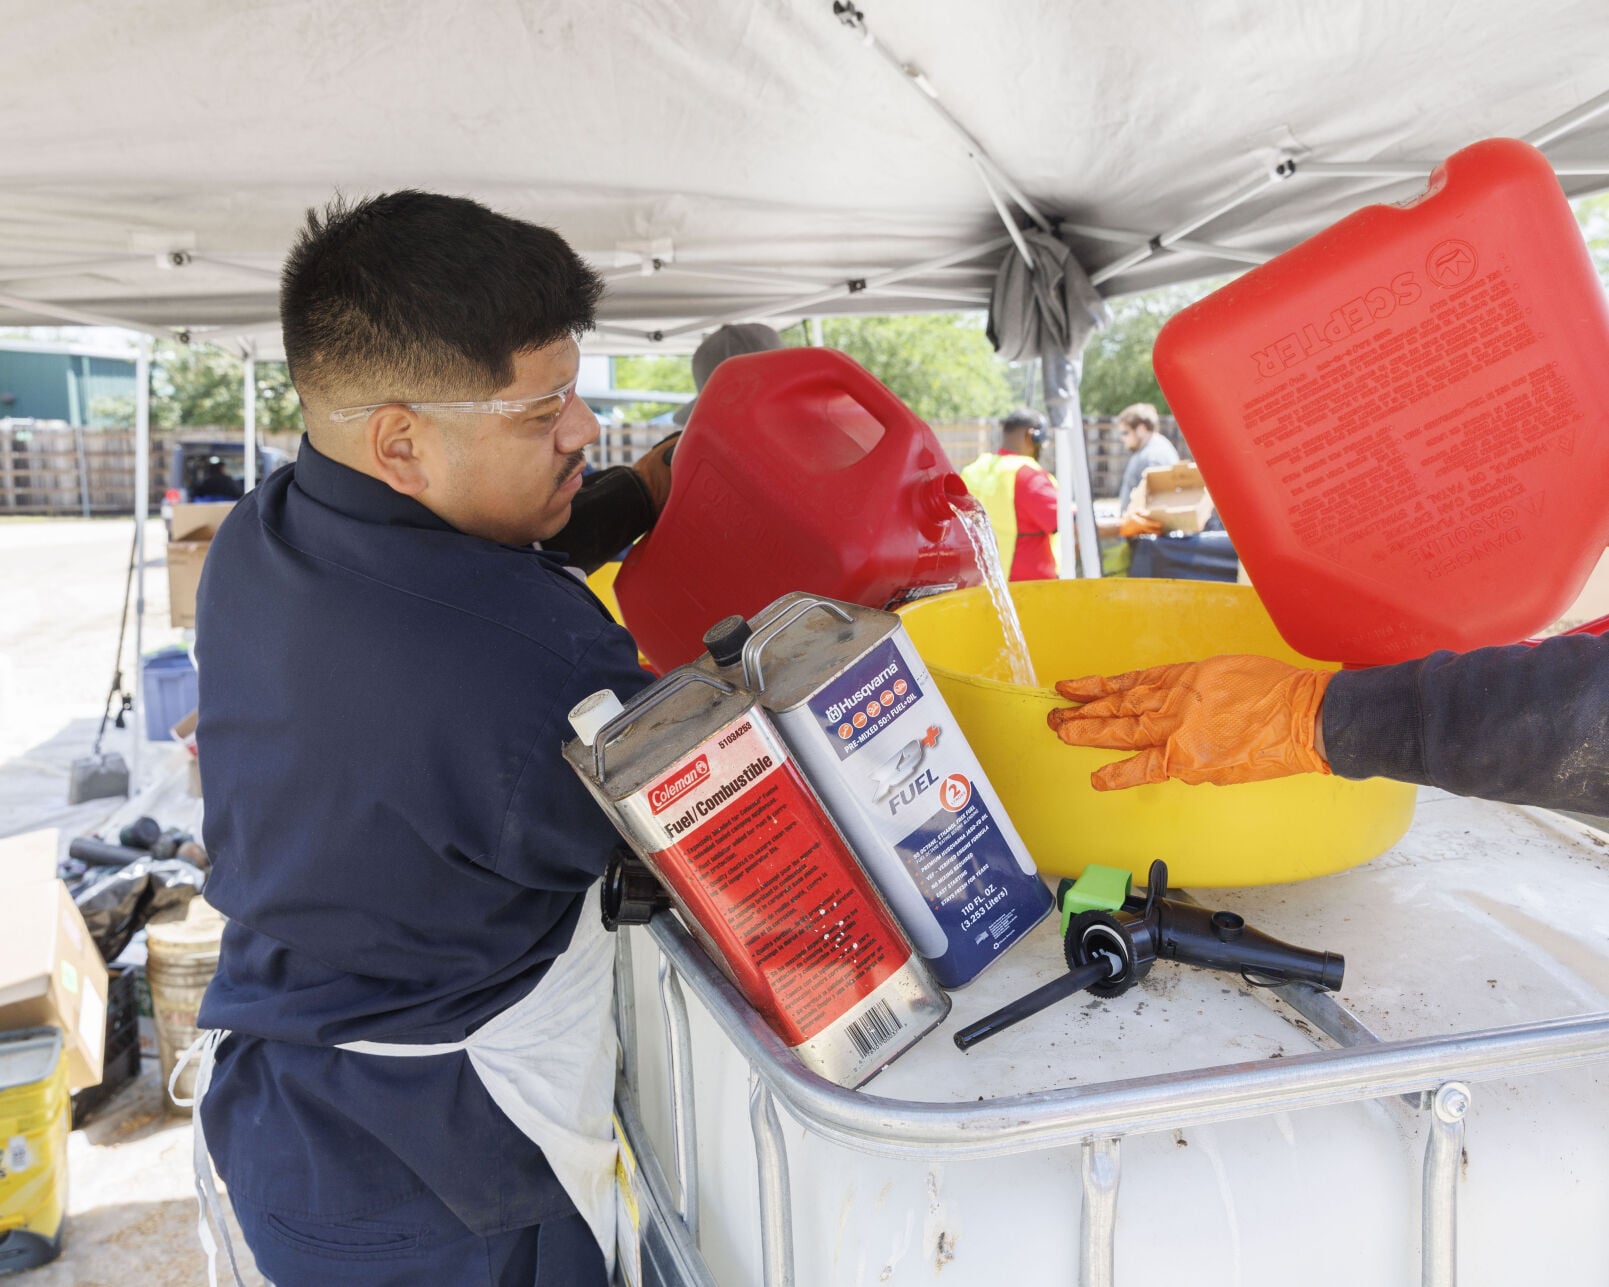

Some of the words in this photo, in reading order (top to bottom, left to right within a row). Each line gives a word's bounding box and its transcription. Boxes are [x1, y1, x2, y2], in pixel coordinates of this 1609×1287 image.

[1250, 269, 1424, 381] SCEPTER
[1404, 502, 1519, 568] GASOLINE
[1422, 525, 1526, 583] DANGER
[838, 660, 899, 714] Husqvarna
[717, 721, 752, 749] 5103A253
[844, 723, 878, 754] PRE-MIXED
[877, 712, 891, 727] 50:1
[890, 691, 917, 716] FUEL+OIL
[648, 766, 699, 807] Coleman
[663, 752, 774, 839] Fuel/Combustible
[886, 767, 939, 816] FUEL
[947, 781, 961, 798] 2
[964, 804, 975, 815] FUEL
[969, 824, 989, 843] FORMULA
[940, 892, 955, 906] STAYS
[966, 874, 976, 884] FOR
[975, 862, 989, 877] YEARS
[946, 869, 968, 889] STARTING
[960, 901, 974, 916] 110
[973, 892, 985, 906] FL.
[983, 882, 997, 897] OZ.
[960, 905, 986, 932] (3.253
[984, 885, 1009, 911] Liters)
